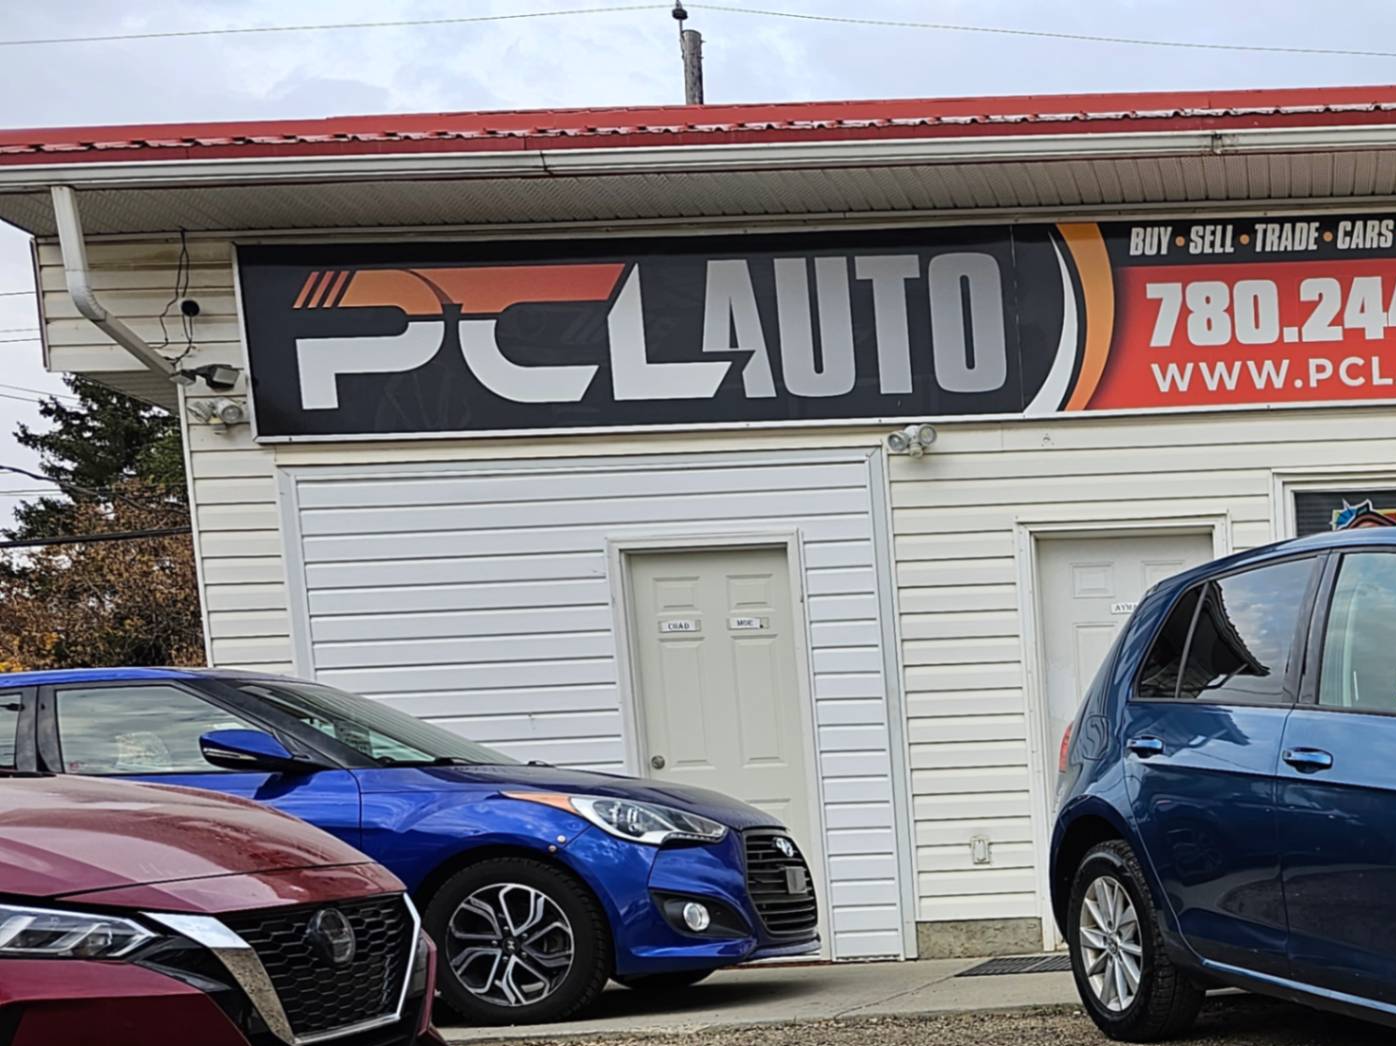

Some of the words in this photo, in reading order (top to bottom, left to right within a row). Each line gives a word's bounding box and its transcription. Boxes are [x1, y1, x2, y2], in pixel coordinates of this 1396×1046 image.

[1129, 226, 1173, 257] BUY
[1188, 224, 1236, 255] SELL
[1253, 221, 1320, 253] TRADE
[1336, 218, 1395, 250] CARS
